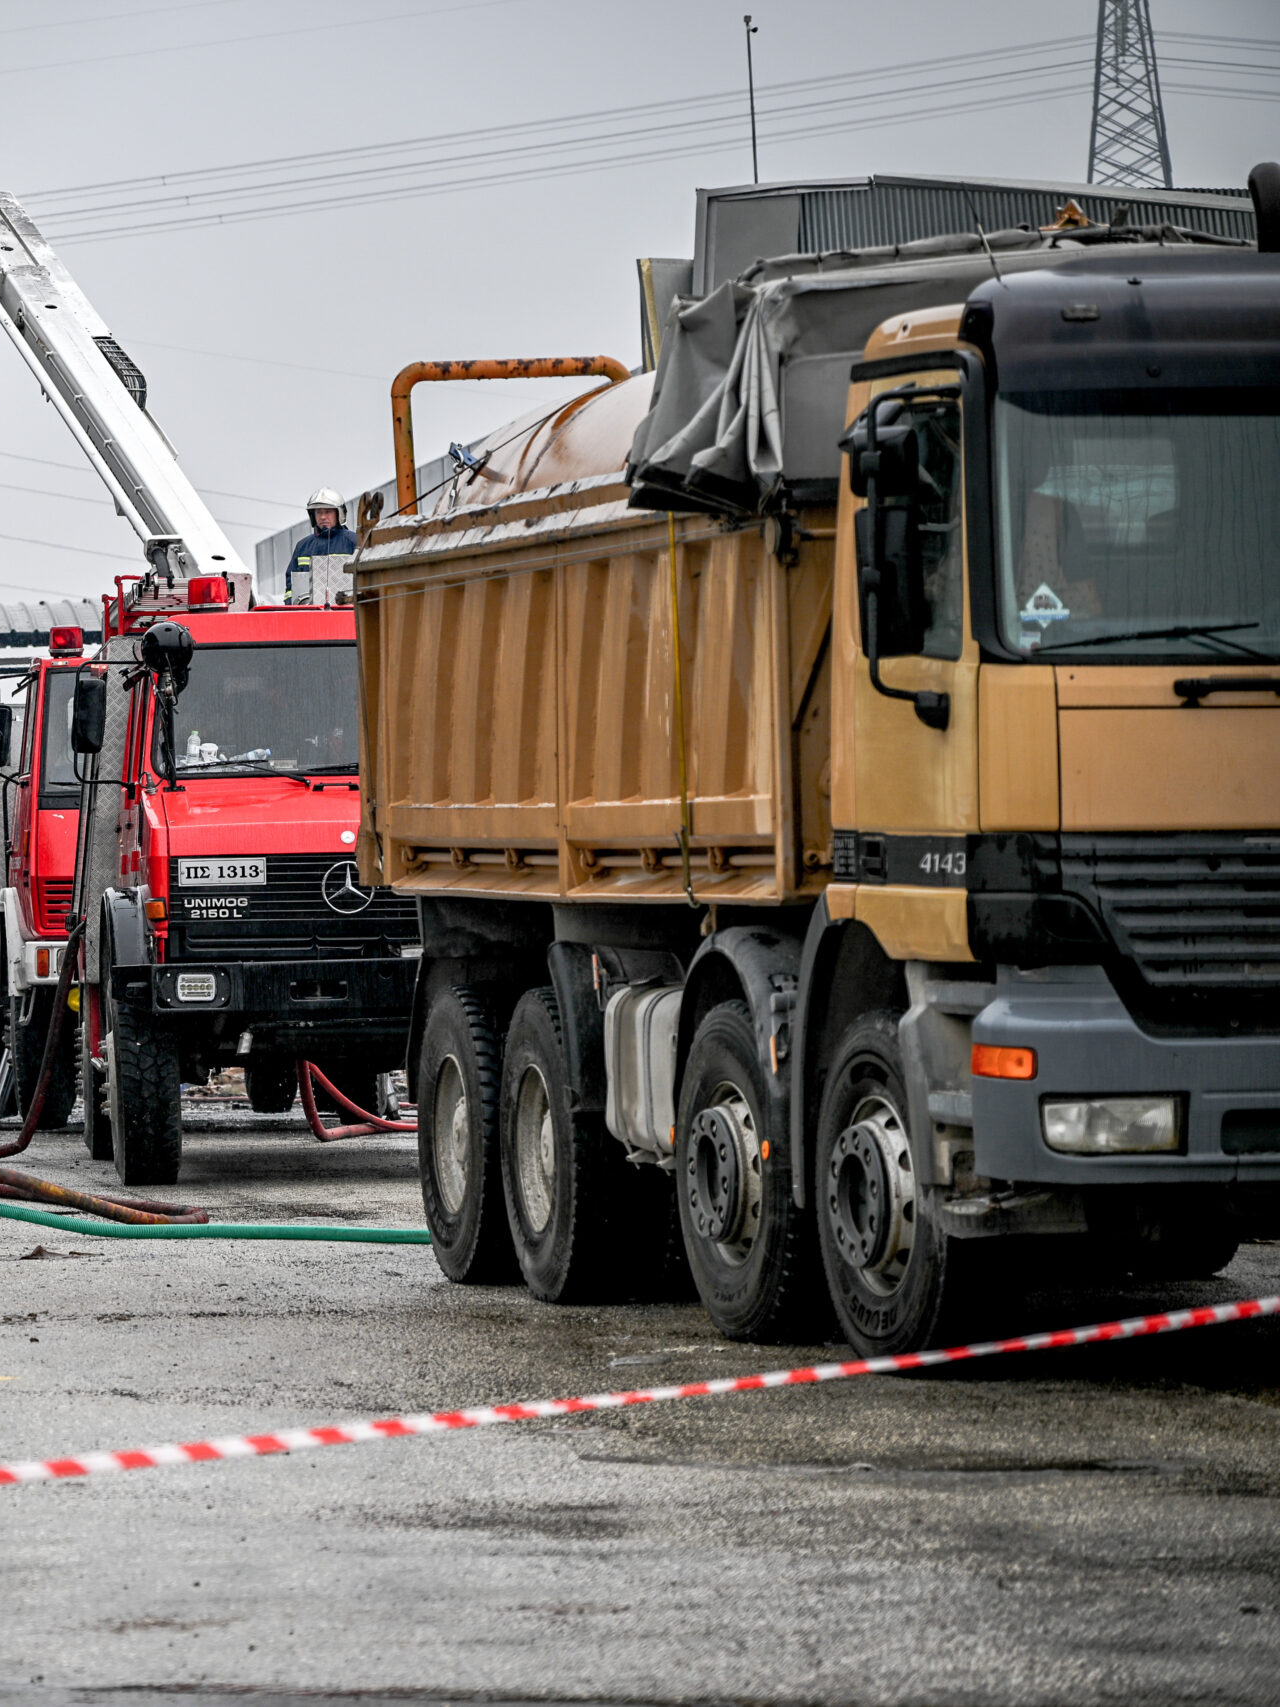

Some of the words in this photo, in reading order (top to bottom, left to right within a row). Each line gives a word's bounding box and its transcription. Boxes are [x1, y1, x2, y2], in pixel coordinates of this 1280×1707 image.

[919, 852, 966, 875] 4143
[185, 866, 211, 879] ΠΣ
[217, 865, 260, 879] 1313
[184, 898, 248, 908] UNIMOG
[190, 908, 229, 918] 2150
[233, 908, 243, 918] L
